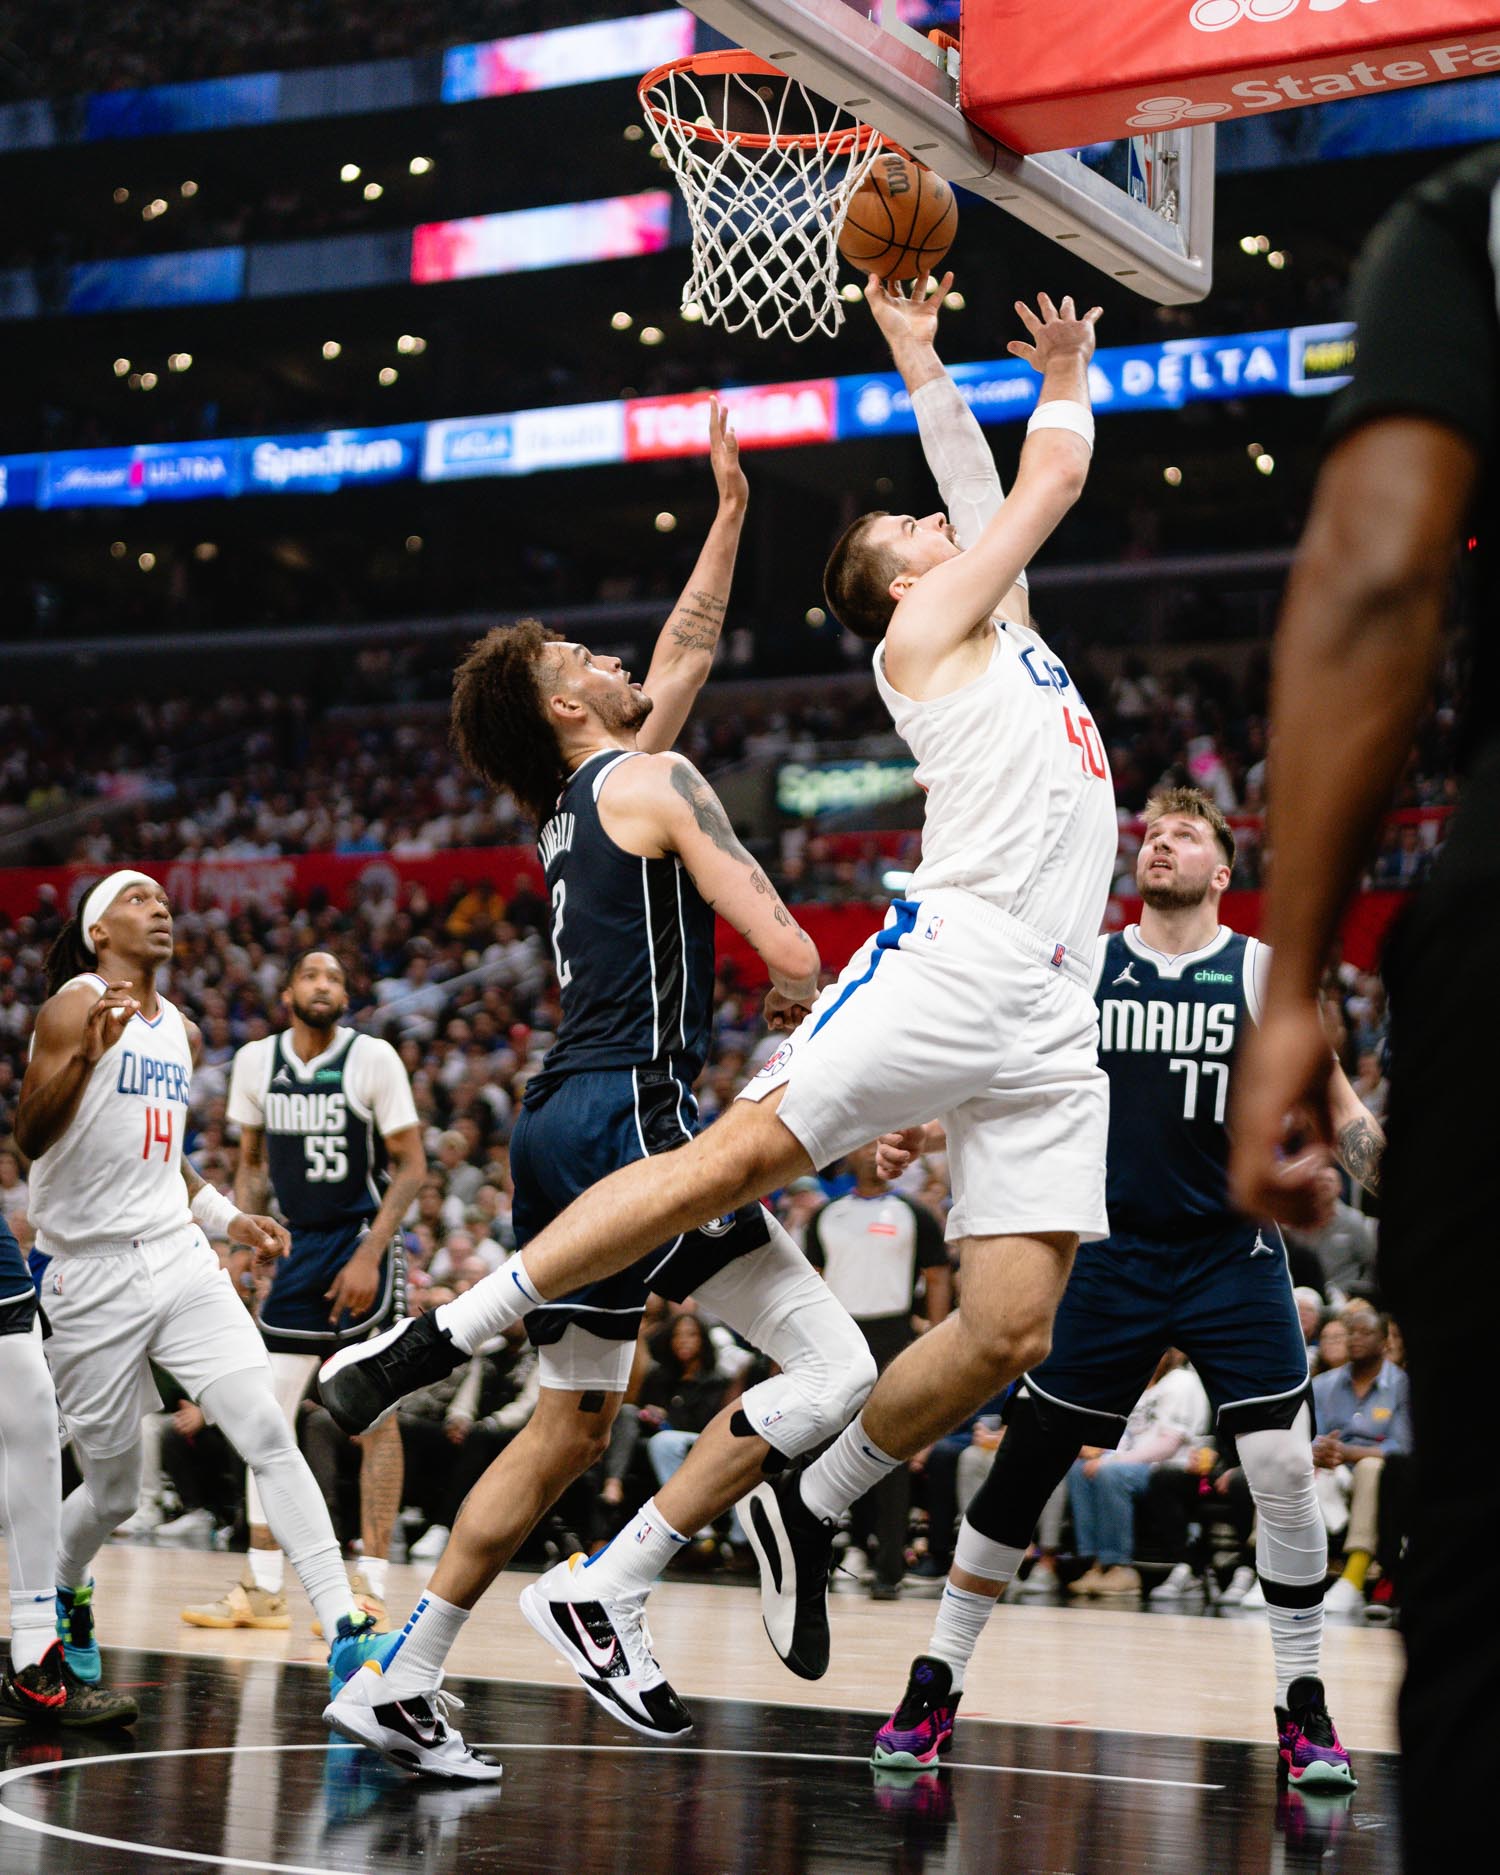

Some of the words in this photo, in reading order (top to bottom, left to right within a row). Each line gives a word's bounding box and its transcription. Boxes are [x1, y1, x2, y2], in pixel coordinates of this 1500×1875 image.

[1231, 59, 1428, 109] State
[1121, 346, 1277, 396] DELTA
[552, 878, 572, 989] 2
[1194, 969, 1233, 983] chime
[1102, 999, 1236, 1055] MAVS
[117, 1050, 189, 1106] CLIPPERS
[1169, 1058, 1229, 1123] 77
[143, 1106, 172, 1162] 14
[265, 1092, 347, 1135] MAVS
[304, 1135, 349, 1182] 55
